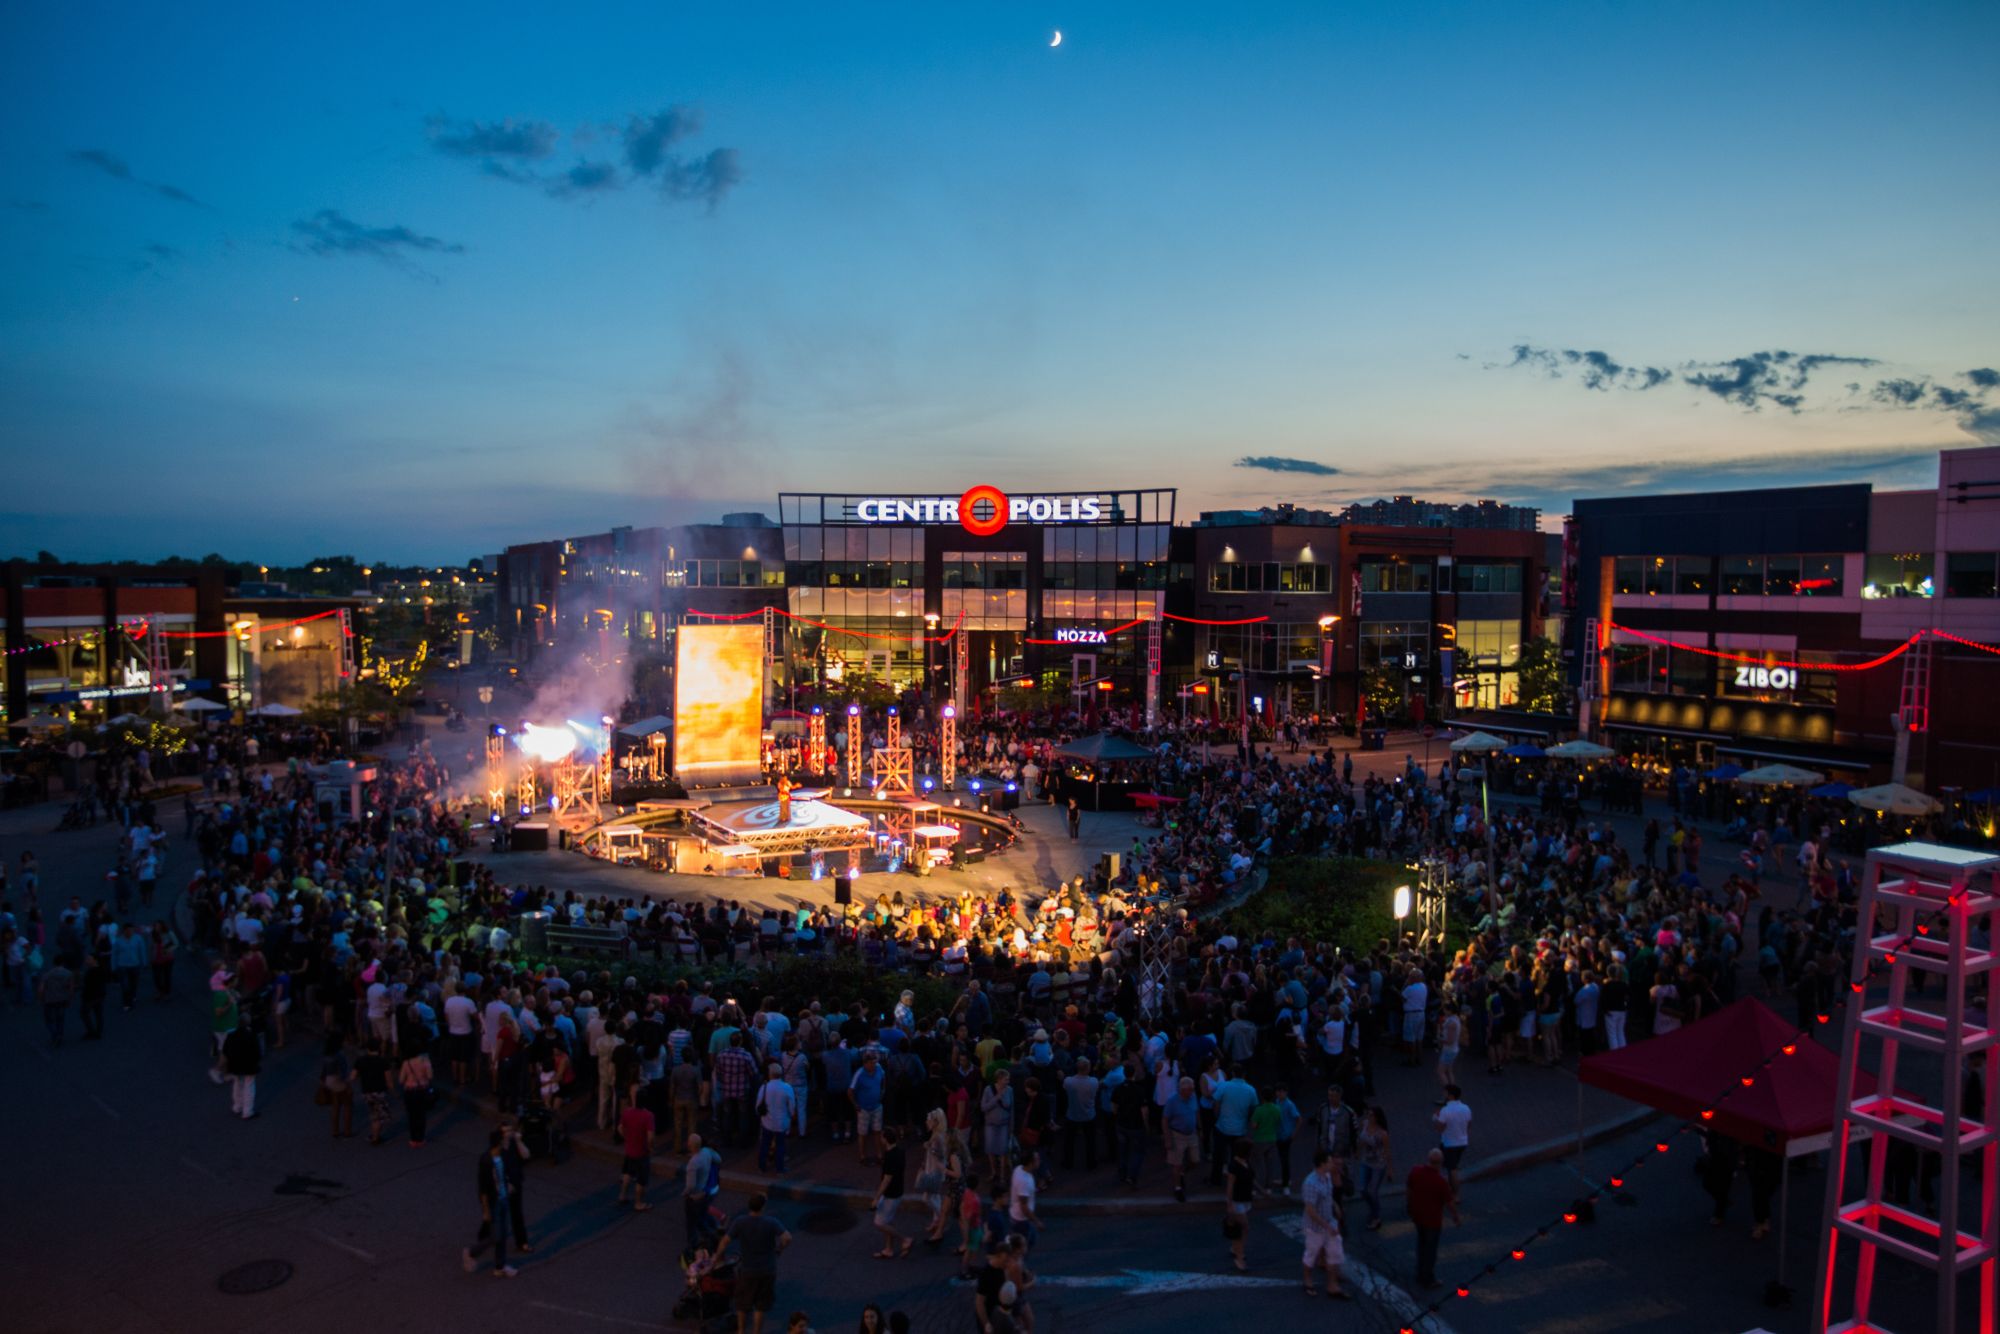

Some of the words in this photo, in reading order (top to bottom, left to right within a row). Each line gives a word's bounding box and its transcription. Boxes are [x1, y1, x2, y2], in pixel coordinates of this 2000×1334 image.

[857, 486, 1101, 535] CENTROPOLIS
[1057, 630, 1107, 643] MOZZA
[1734, 667, 1797, 690] ZIBO!
